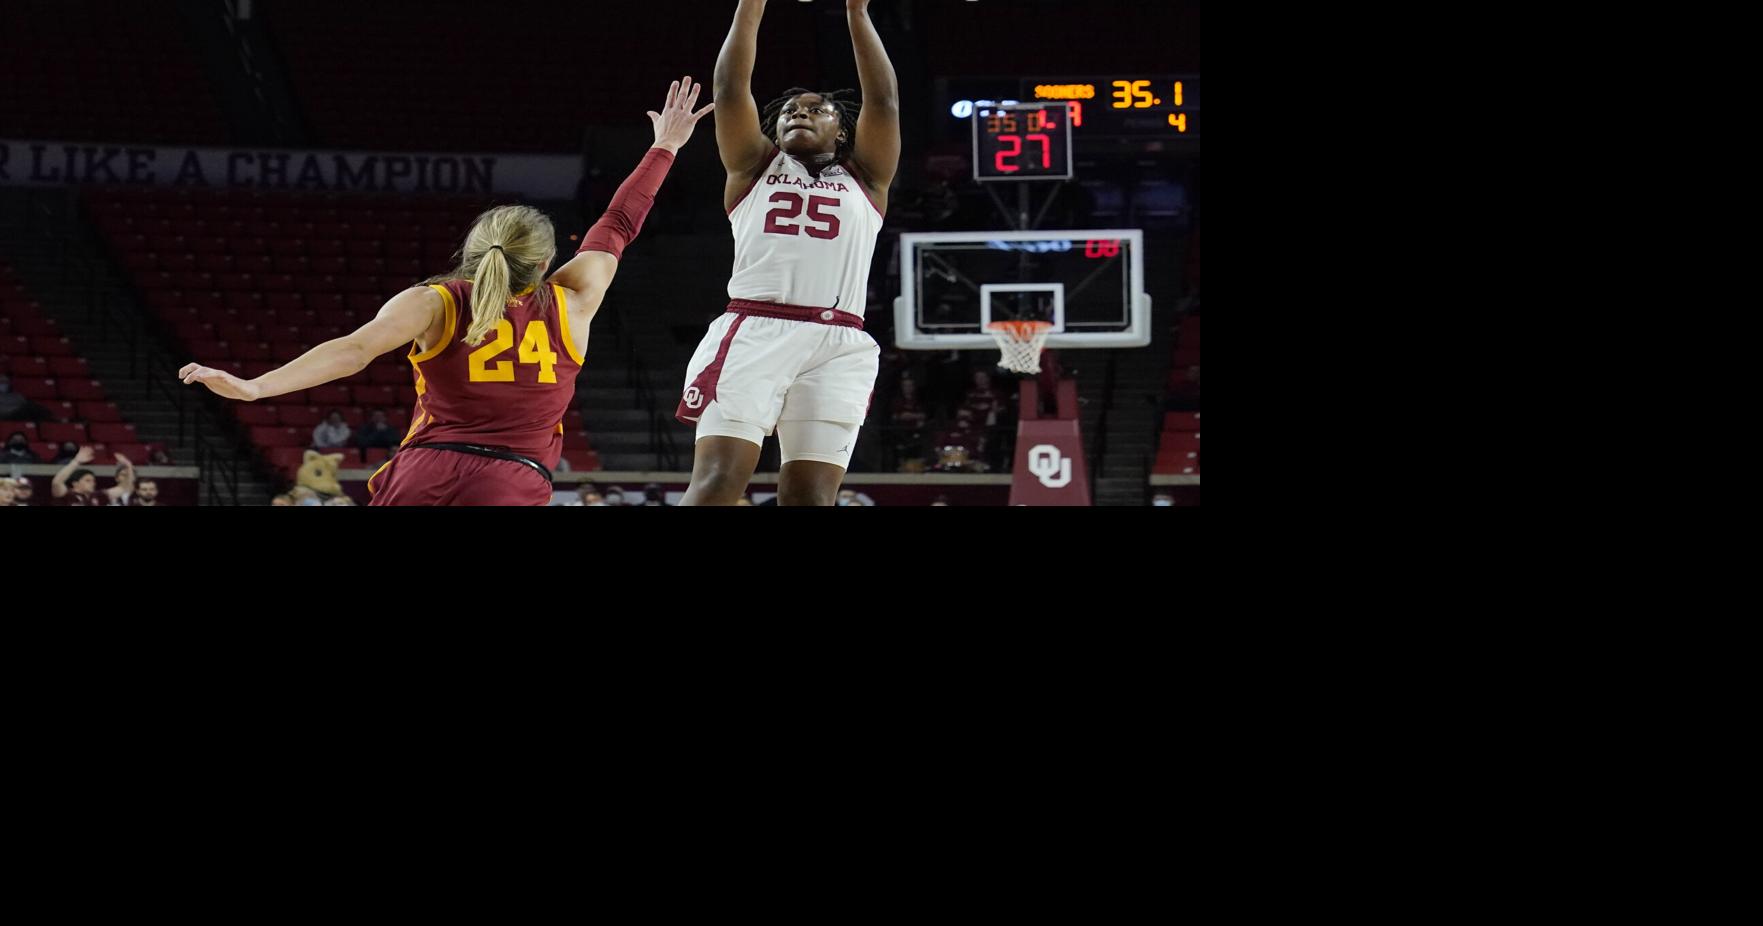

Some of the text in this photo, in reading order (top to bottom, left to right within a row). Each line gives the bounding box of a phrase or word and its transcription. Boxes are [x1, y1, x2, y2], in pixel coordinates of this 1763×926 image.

[1168, 113, 1186, 132] 4
[29, 144, 156, 184] LIKE
[174, 150, 209, 187] A
[227, 152, 497, 193] CHAMPION
[995, 134, 1051, 171] 27
[766, 173, 849, 192] OKLAHOMA
[764, 191, 841, 240] 25
[468, 318, 557, 384] 24
[683, 386, 704, 409] OU
[1028, 444, 1072, 488] OU
